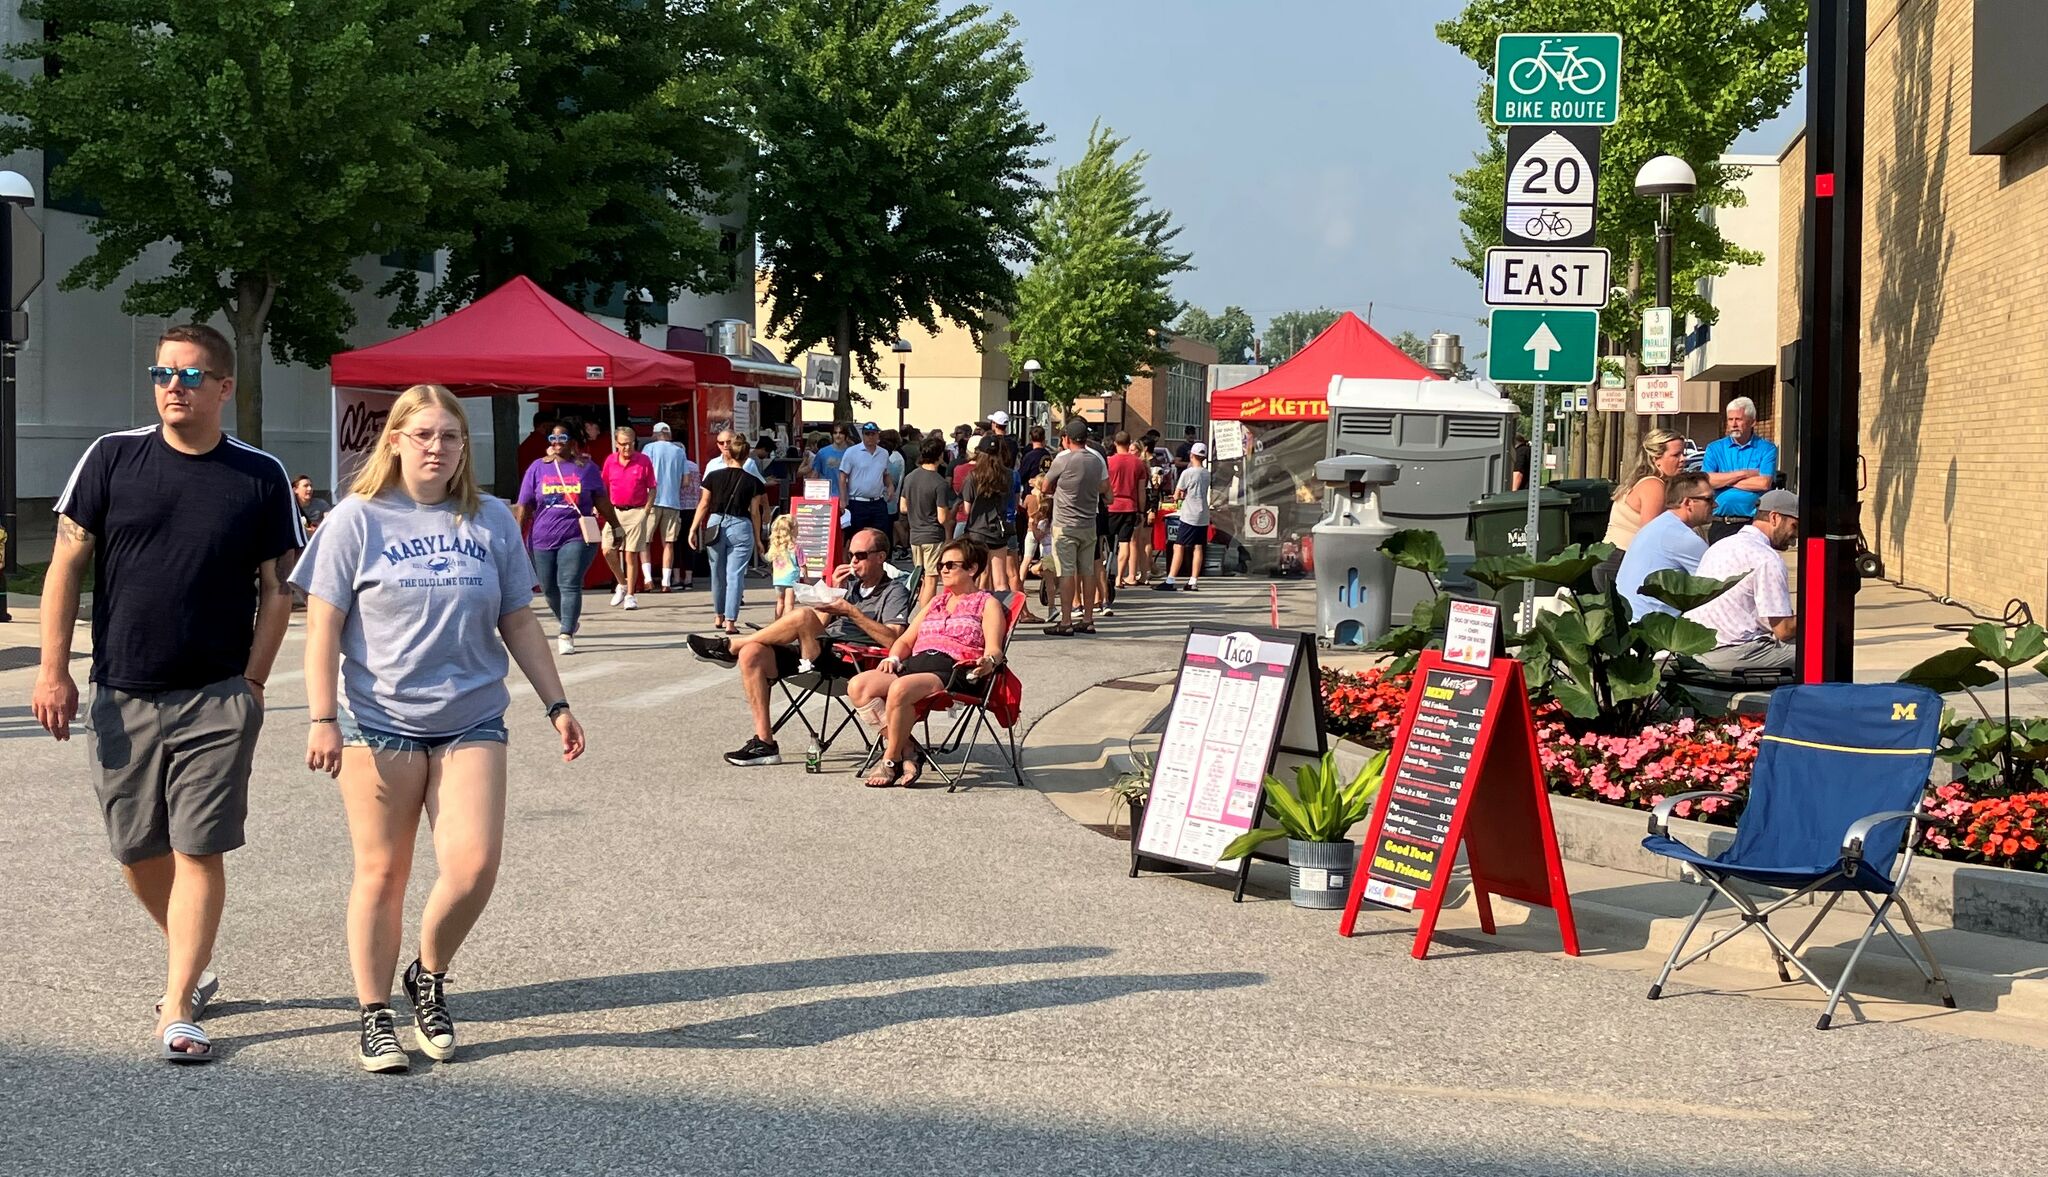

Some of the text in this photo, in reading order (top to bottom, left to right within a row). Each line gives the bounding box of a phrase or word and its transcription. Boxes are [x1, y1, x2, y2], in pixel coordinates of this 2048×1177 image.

[1505, 102, 1606, 119] BIKE ROUTE
[1522, 157, 1581, 195] 20
[1504, 259, 1590, 296] EAST
[1644, 338, 1668, 347] PARALLEL
[1646, 350, 1667, 360] PARKING
[1641, 391, 1674, 399] OVERTIME
[1269, 398, 1329, 415] KETTL
[1649, 401, 1665, 409] FINE
[341, 401, 389, 451] NAT
[542, 483, 581, 495] bread
[399, 577, 483, 588] THE OLD LINE STATE
[1453, 603, 1479, 613] VOUCHER
[1224, 636, 1253, 663] TACO
[1891, 703, 1918, 720] M
[1384, 839, 1410, 856] Good
[1409, 846, 1434, 863] Food
[1374, 856, 1432, 882] With Friends
